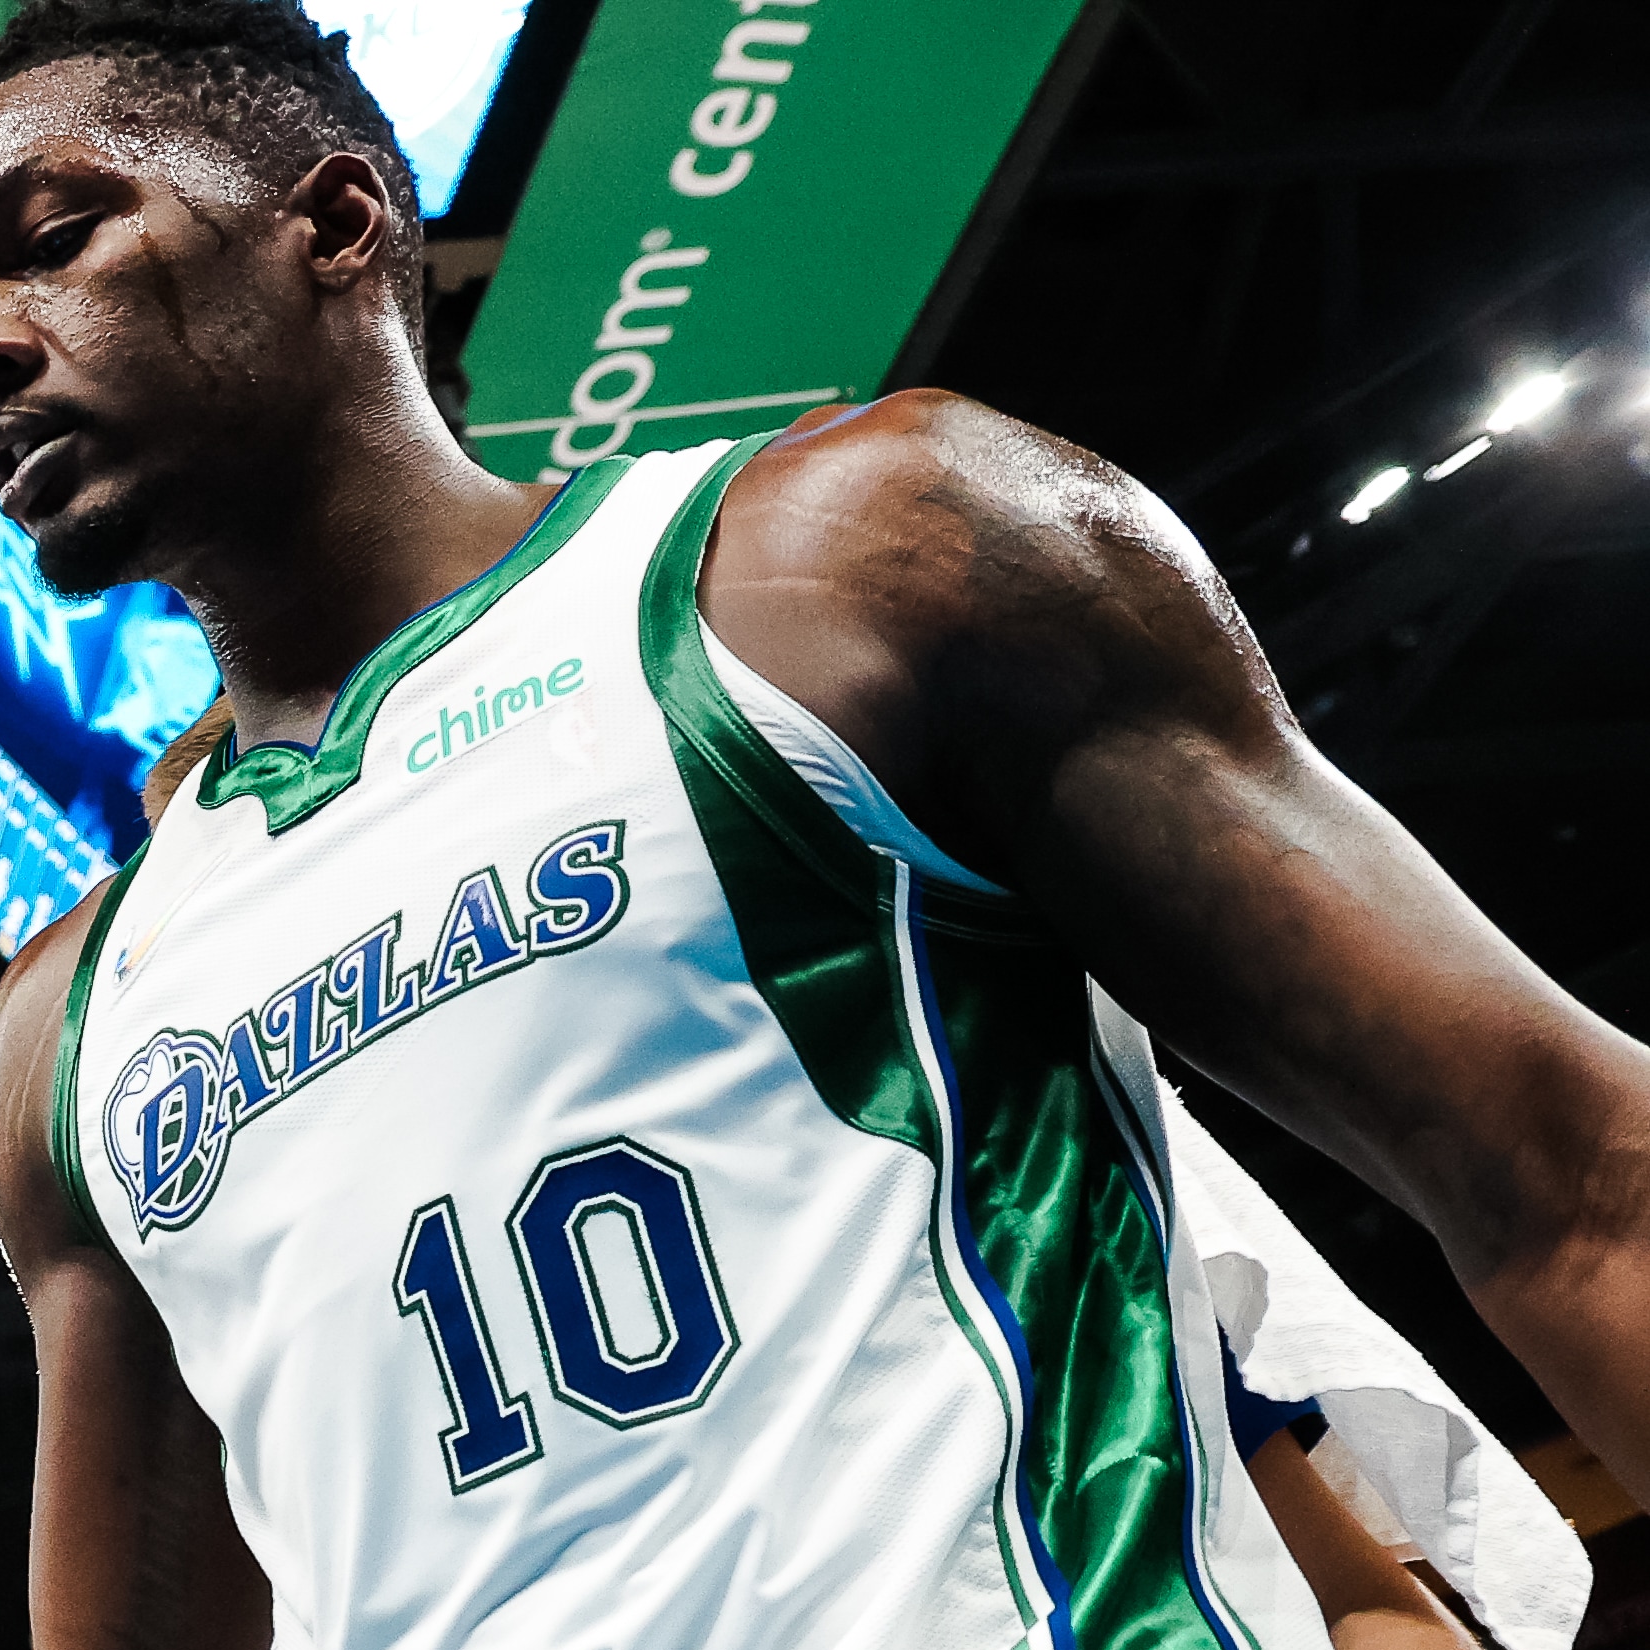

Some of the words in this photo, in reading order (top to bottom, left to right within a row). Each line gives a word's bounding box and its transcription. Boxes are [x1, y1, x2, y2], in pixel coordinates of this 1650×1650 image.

[539, 246, 711, 484] com
[668, 0, 818, 198] cen
[405, 656, 585, 776] chime
[103, 819, 628, 1238] DALLAS
[392, 1135, 741, 1496] 10
